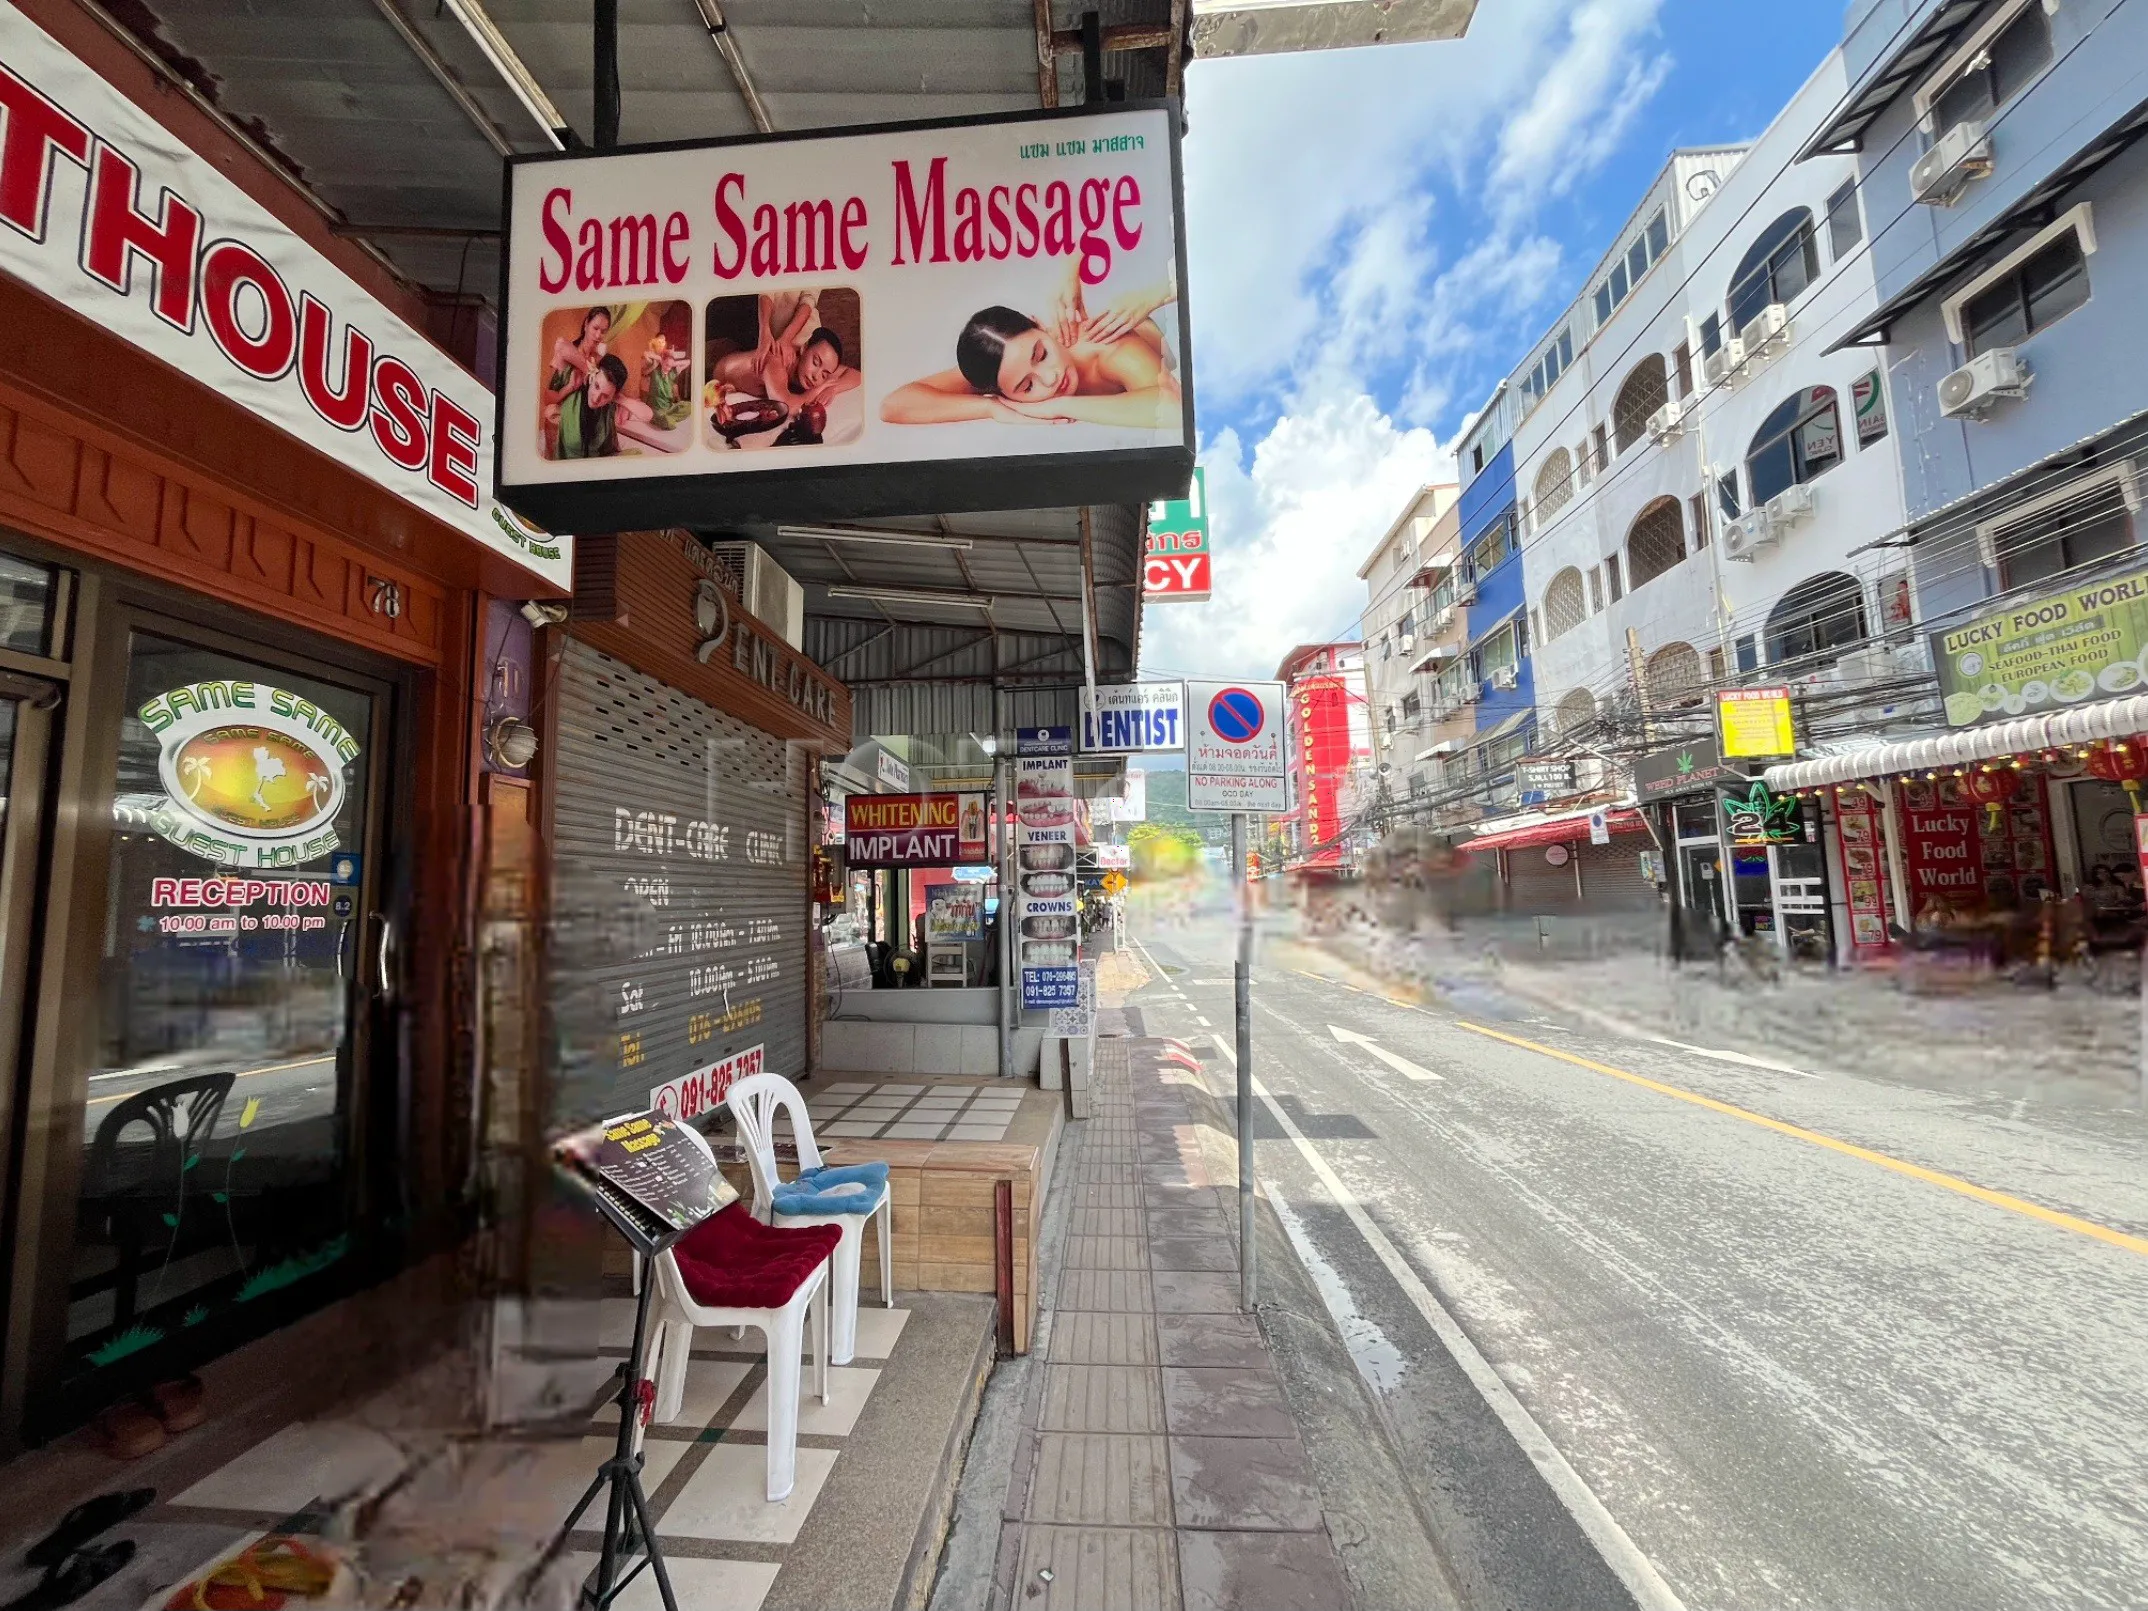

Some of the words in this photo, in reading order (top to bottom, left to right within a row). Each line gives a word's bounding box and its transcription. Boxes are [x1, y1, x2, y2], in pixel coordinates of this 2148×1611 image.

[539, 187, 690, 294] Same
[713, 172, 869, 281] Same
[890, 156, 1143, 285] Massage
[491, 507, 527, 548] GUEST
[529, 541, 561, 560] HOUSE
[367, 575, 401, 618] 78
[1946, 621, 2003, 652] LUCKY
[2013, 603, 2067, 632] FOOD
[2082, 630, 2122, 648] FOOD
[2002, 660, 2066, 683] EUROPEAN
[2071, 649, 2109, 666] FOOD
[137, 681, 256, 733] SAME
[270, 688, 362, 764] SAME
[203, 728, 260, 745] SAME
[266, 732, 317, 760] SAME
[1022, 760, 1068, 771] IMPLANT
[1195, 777, 1208, 787] NO
[1209, 777, 1246, 788] PARKING
[1248, 778, 1277, 788] ALONG
[1644, 777, 1673, 791] WEED
[1676, 766, 1719, 785] PLANET
[850, 802, 956, 826] WHITENING
[1912, 814, 1970, 836] Lucky
[149, 809, 247, 865] GUEST
[257, 829, 341, 867] HOUSE
[850, 835, 955, 860] IMPLANT
[1028, 831, 1066, 841] VENEER
[1100, 857, 1128, 866] Doctor
[1921, 841, 1968, 859] Food
[1917, 867, 1977, 886] World
[151, 878, 331, 907] RECEPTION
[1027, 902, 1072, 912] CROWNS
[160, 915, 206, 932] 10.00
[210, 917, 236, 930] am
[241, 917, 257, 930] to
[263, 914, 300, 930] 10.00
[303, 916, 326, 931] pm
[1025, 971, 1039, 982] TEL:
[1026, 985, 1056, 997] 091-825
[1059, 984, 1075, 996] 7357
